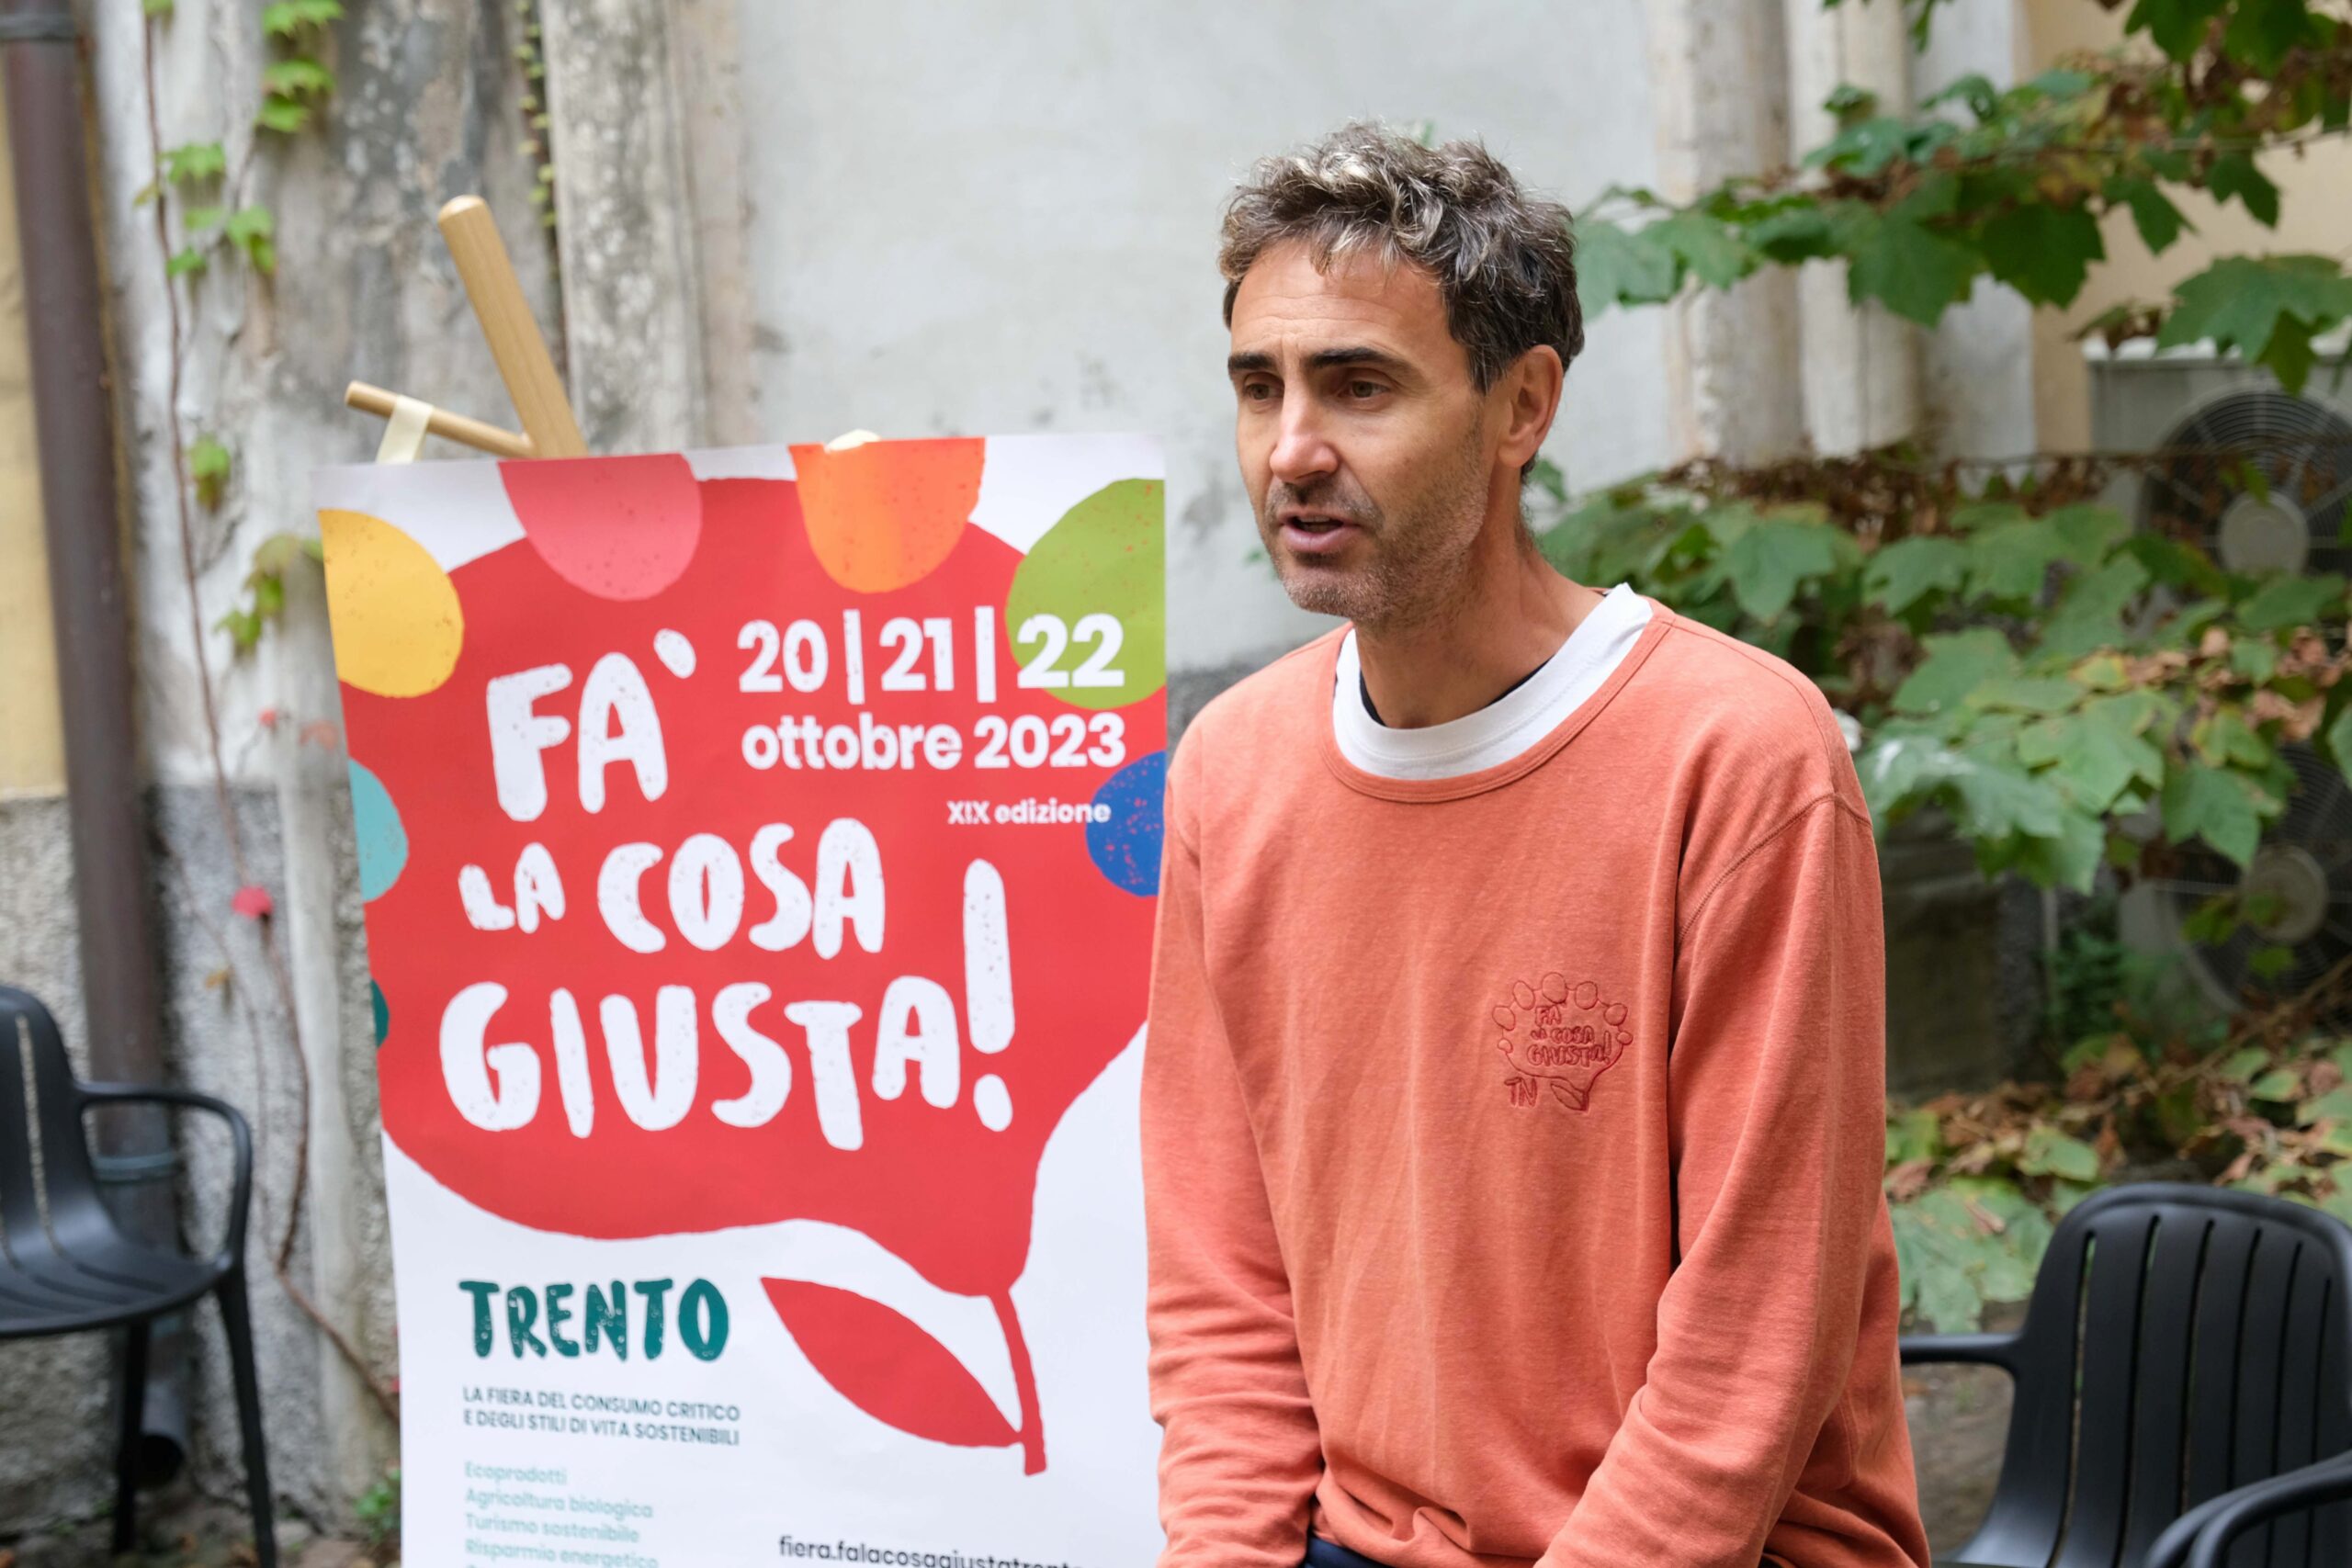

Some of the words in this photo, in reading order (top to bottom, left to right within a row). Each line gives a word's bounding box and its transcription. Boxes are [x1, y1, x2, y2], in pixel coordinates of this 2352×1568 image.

[741, 712, 963, 770] ottobre
[973, 712, 1126, 768] 2023
[947, 800, 990, 824] XIX
[994, 797, 1112, 824] edizione
[458, 841, 566, 933] LA
[597, 818, 886, 959] COSA
[438, 858, 1016, 1151] GIUSTA!
[1527, 1031, 1612, 1067] GIUSTA!
[1551, 1025, 1595, 1043] COSA
[1504, 1077, 1538, 1107] TN
[458, 1278, 729, 1361] TRENTO
[463, 1387, 482, 1403] LA
[487, 1388, 534, 1406] FIERA
[537, 1391, 566, 1410] DEL
[571, 1393, 662, 1416] CONSUMO
[666, 1400, 741, 1422] CRITICO
[463, 1410, 472, 1425] E
[476, 1410, 525, 1429] DEGLI
[527, 1414, 566, 1432] STILI
[570, 1417, 588, 1434] DI
[591, 1419, 630, 1438] VITA
[634, 1422, 741, 1446] SOSTENIBILI
[465, 1461, 567, 1484] Ecoprodotti
[465, 1487, 566, 1510] Agricoltura
[569, 1495, 654, 1520] biologica
[465, 1512, 538, 1534] Turismo
[541, 1520, 640, 1542] sostenibile
[465, 1538, 557, 1562] Risparmio
[560, 1548, 659, 1568] energetico
